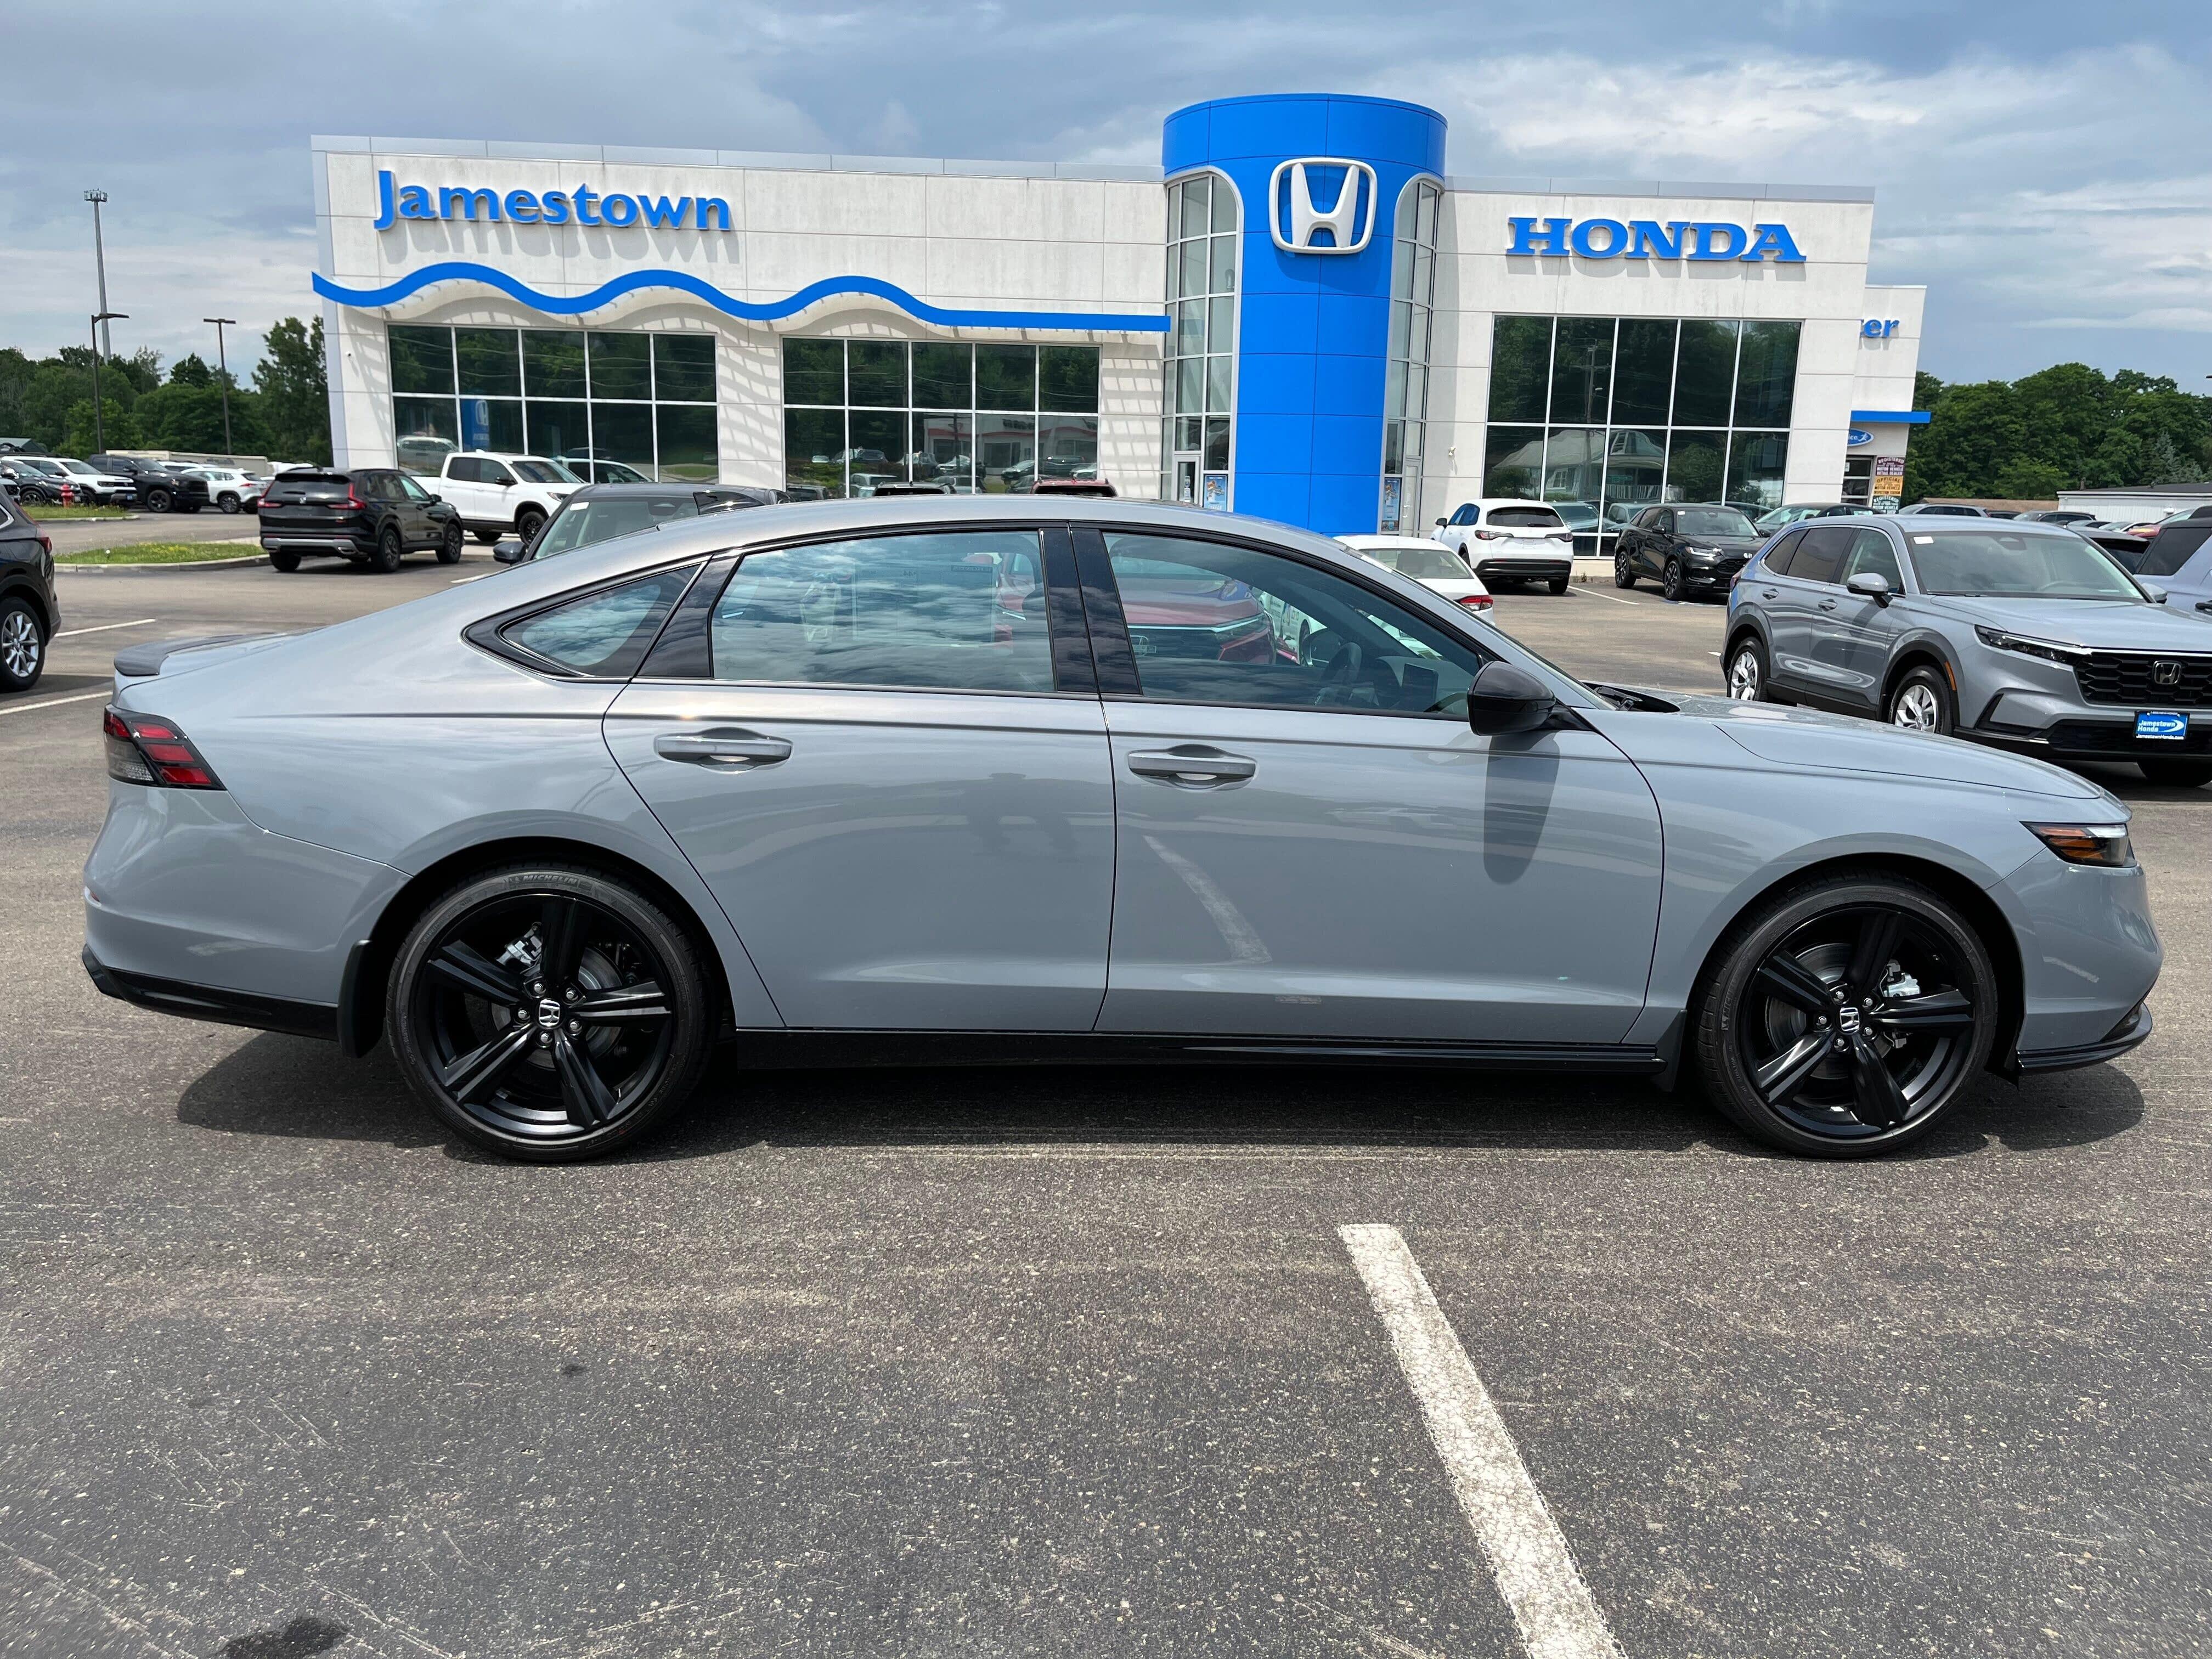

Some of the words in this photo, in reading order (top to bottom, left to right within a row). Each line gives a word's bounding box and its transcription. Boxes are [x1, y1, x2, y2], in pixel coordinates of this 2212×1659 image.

[374, 171, 731, 230] Jamestown
[1505, 217, 1806, 262] HONDA
[1860, 319, 1899, 338] er
[522, 874, 578, 884] MICHELIN
